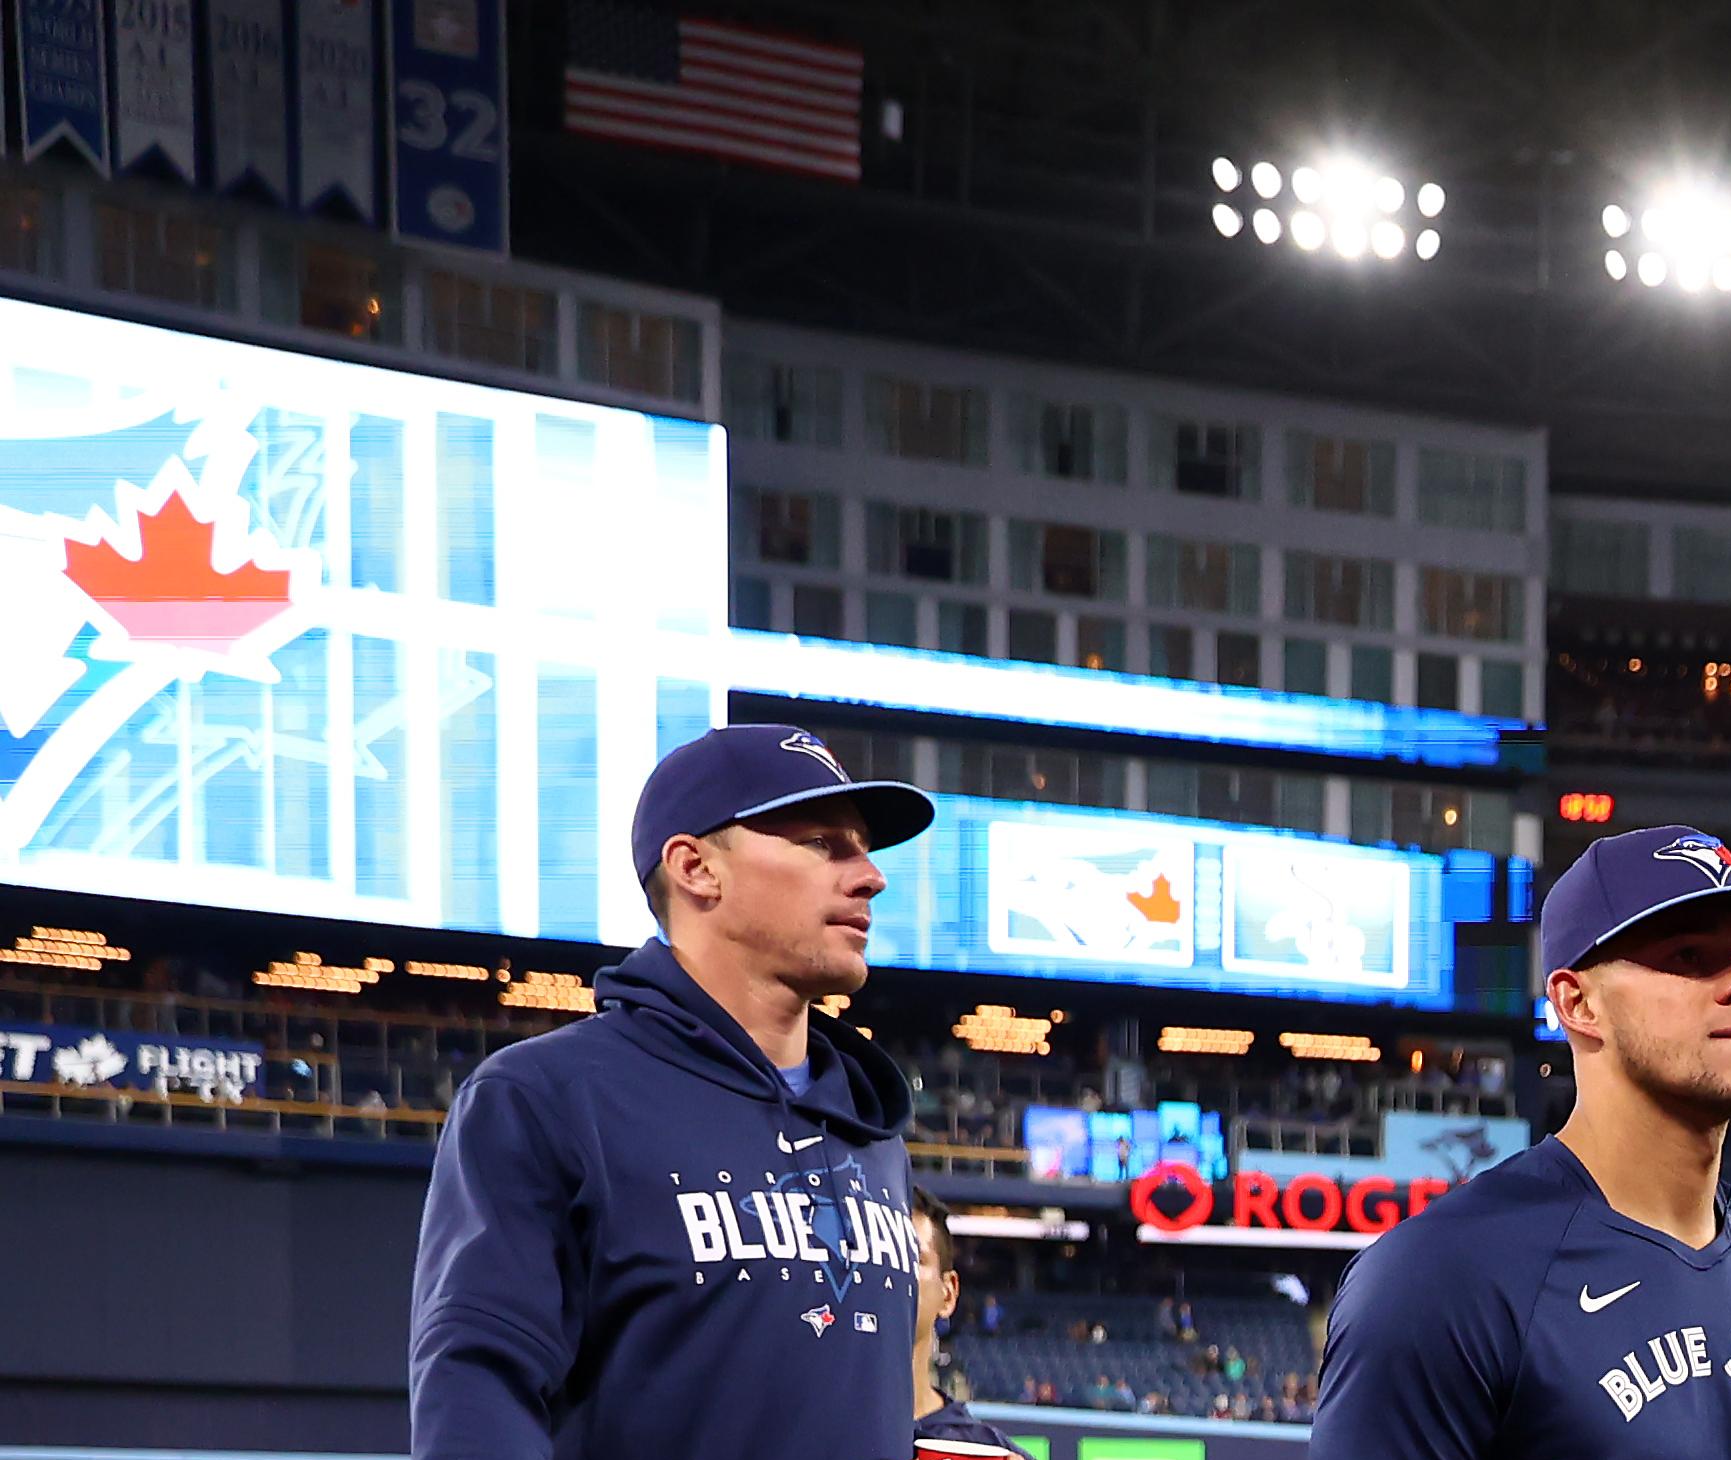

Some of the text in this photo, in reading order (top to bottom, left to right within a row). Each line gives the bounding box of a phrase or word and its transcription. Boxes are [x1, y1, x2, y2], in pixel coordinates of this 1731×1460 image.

[400, 79, 499, 163] 32
[137, 1043, 262, 1083] FLIGHT
[676, 1190, 920, 1281] BLUE JAYS
[1233, 1170, 1468, 1232] ROGE
[1598, 1326, 1712, 1423] BLUE
